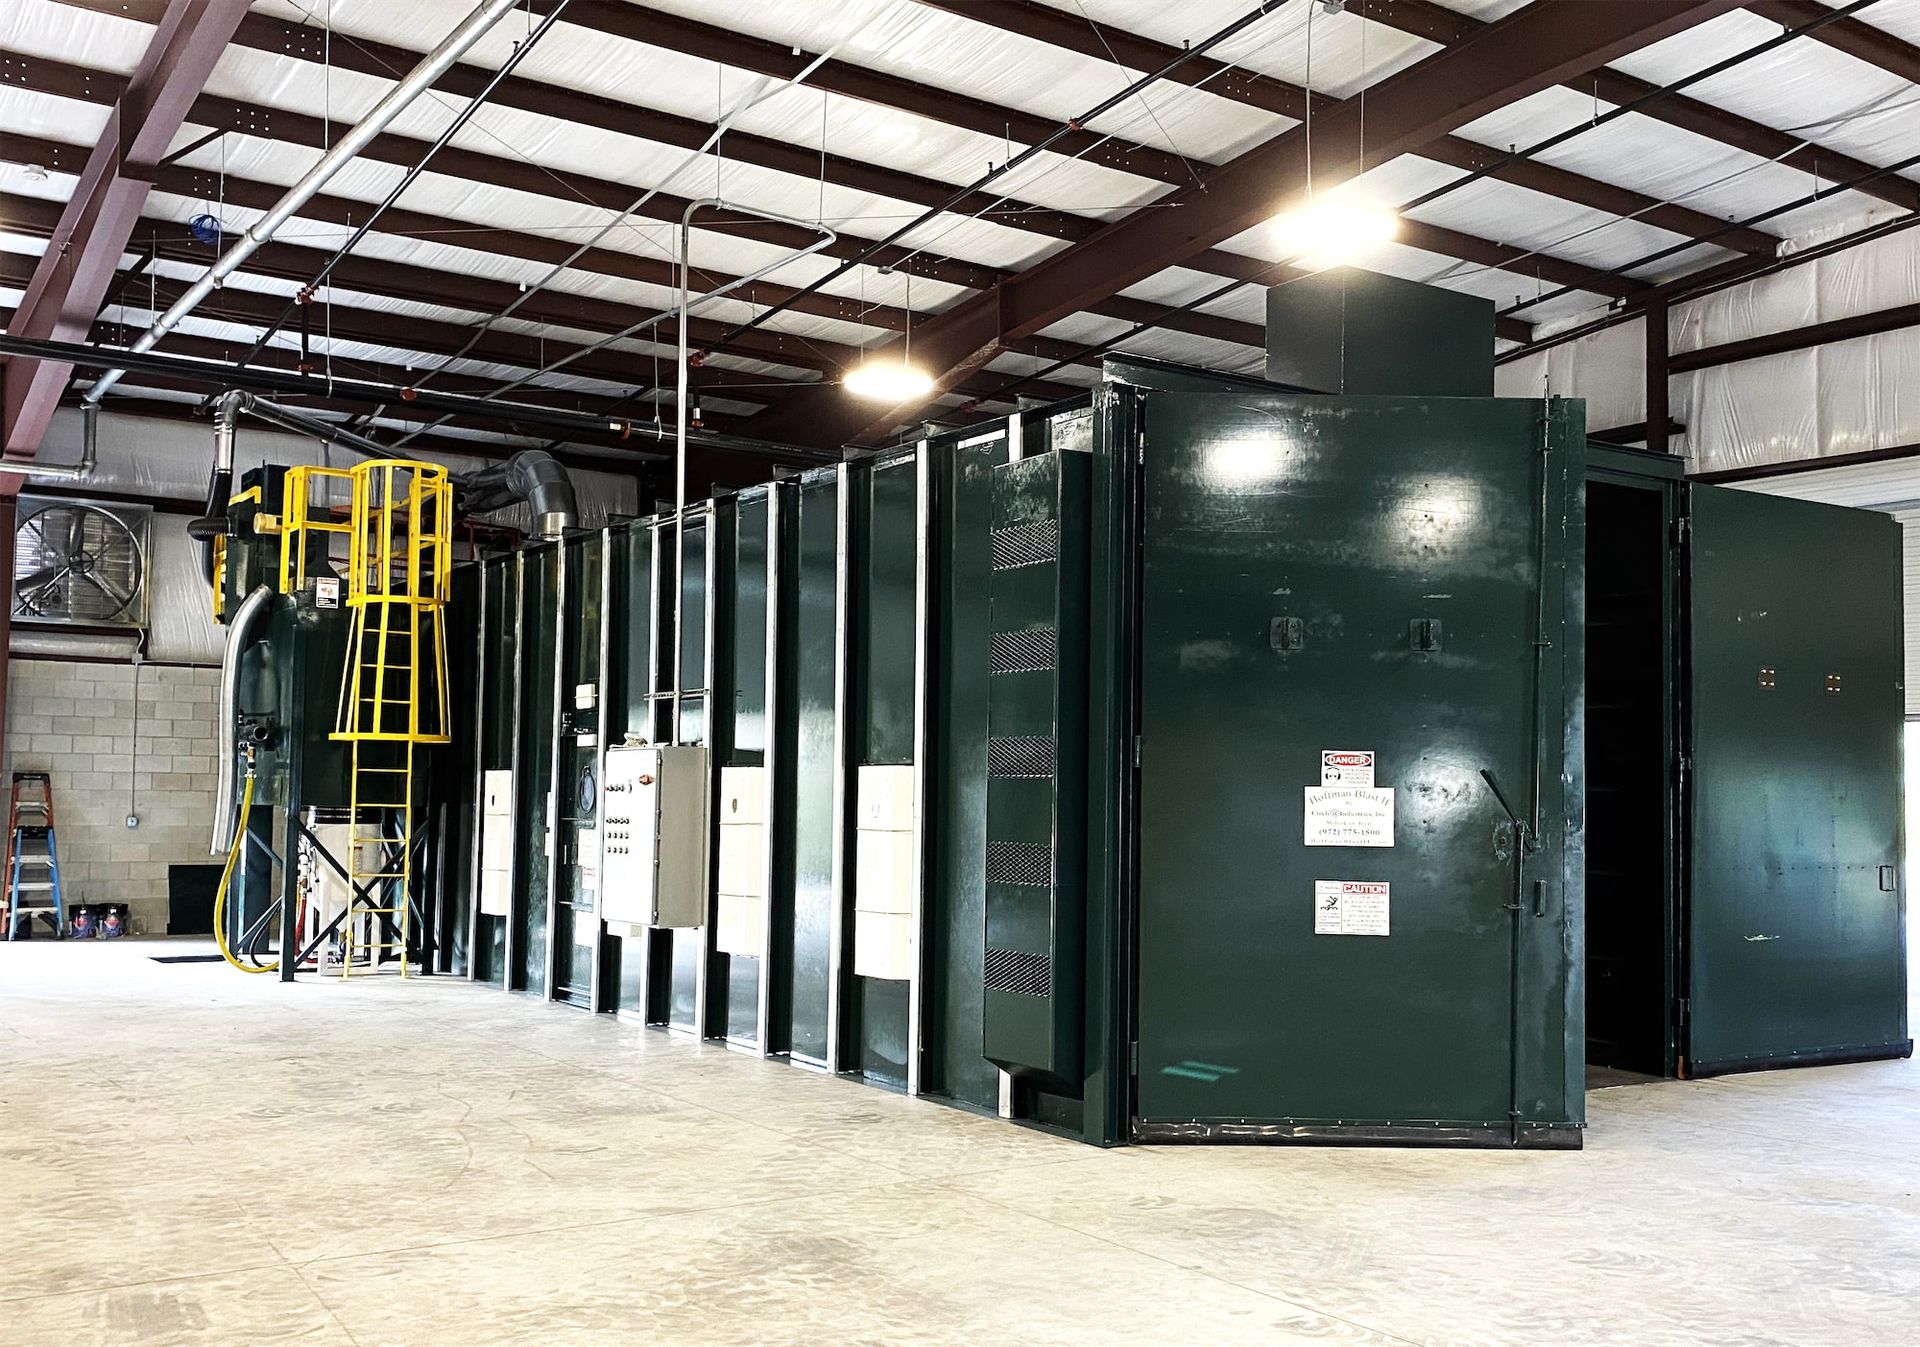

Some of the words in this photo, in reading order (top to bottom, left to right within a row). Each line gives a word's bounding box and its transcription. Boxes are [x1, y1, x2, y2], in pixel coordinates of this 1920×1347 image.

[1330, 756, 1366, 764] DANGER
[1309, 791, 1352, 804] Hoffman
[1355, 790, 1379, 801] Blast
[1319, 828, 1340, 836] (972)
[1344, 885, 1386, 893] CAUTION
